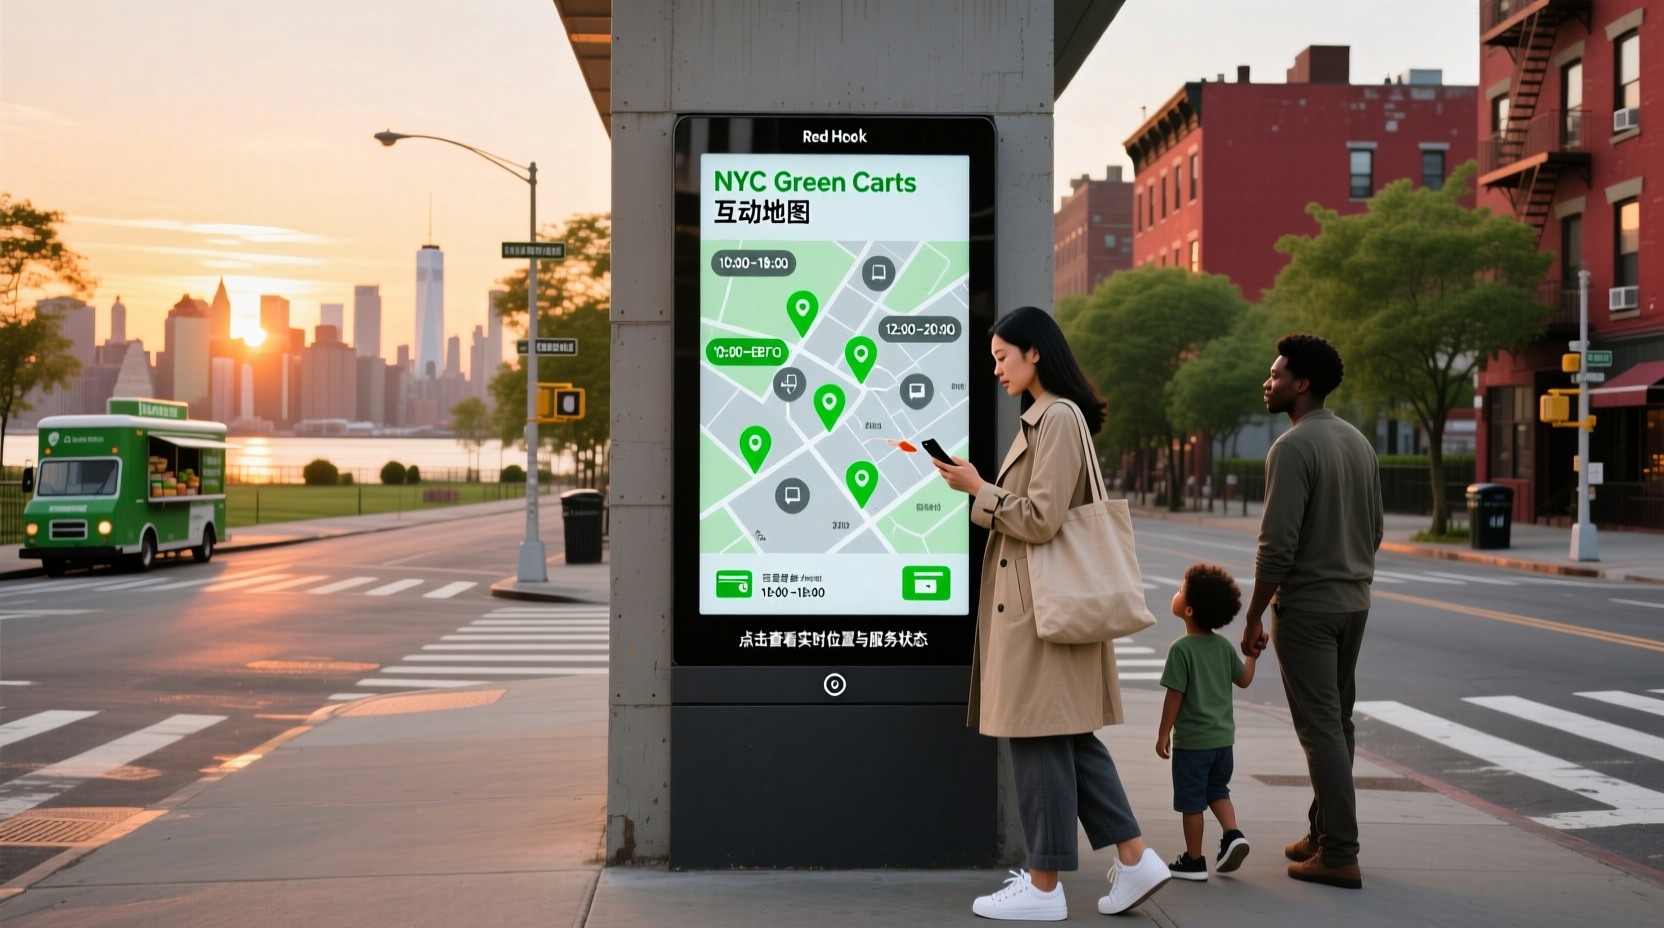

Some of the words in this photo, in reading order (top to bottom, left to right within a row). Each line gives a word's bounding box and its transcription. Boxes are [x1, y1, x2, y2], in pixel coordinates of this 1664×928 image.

[803, 130, 828, 143] Red
[832, 129, 868, 143] Hook
[714, 171, 767, 193] NYC
[774, 171, 846, 193] Green
[853, 171, 917, 193] Carts
[714, 199, 810, 225] 互动地图
[738, 630, 928, 648] 点击查看实时位置与服务状态
